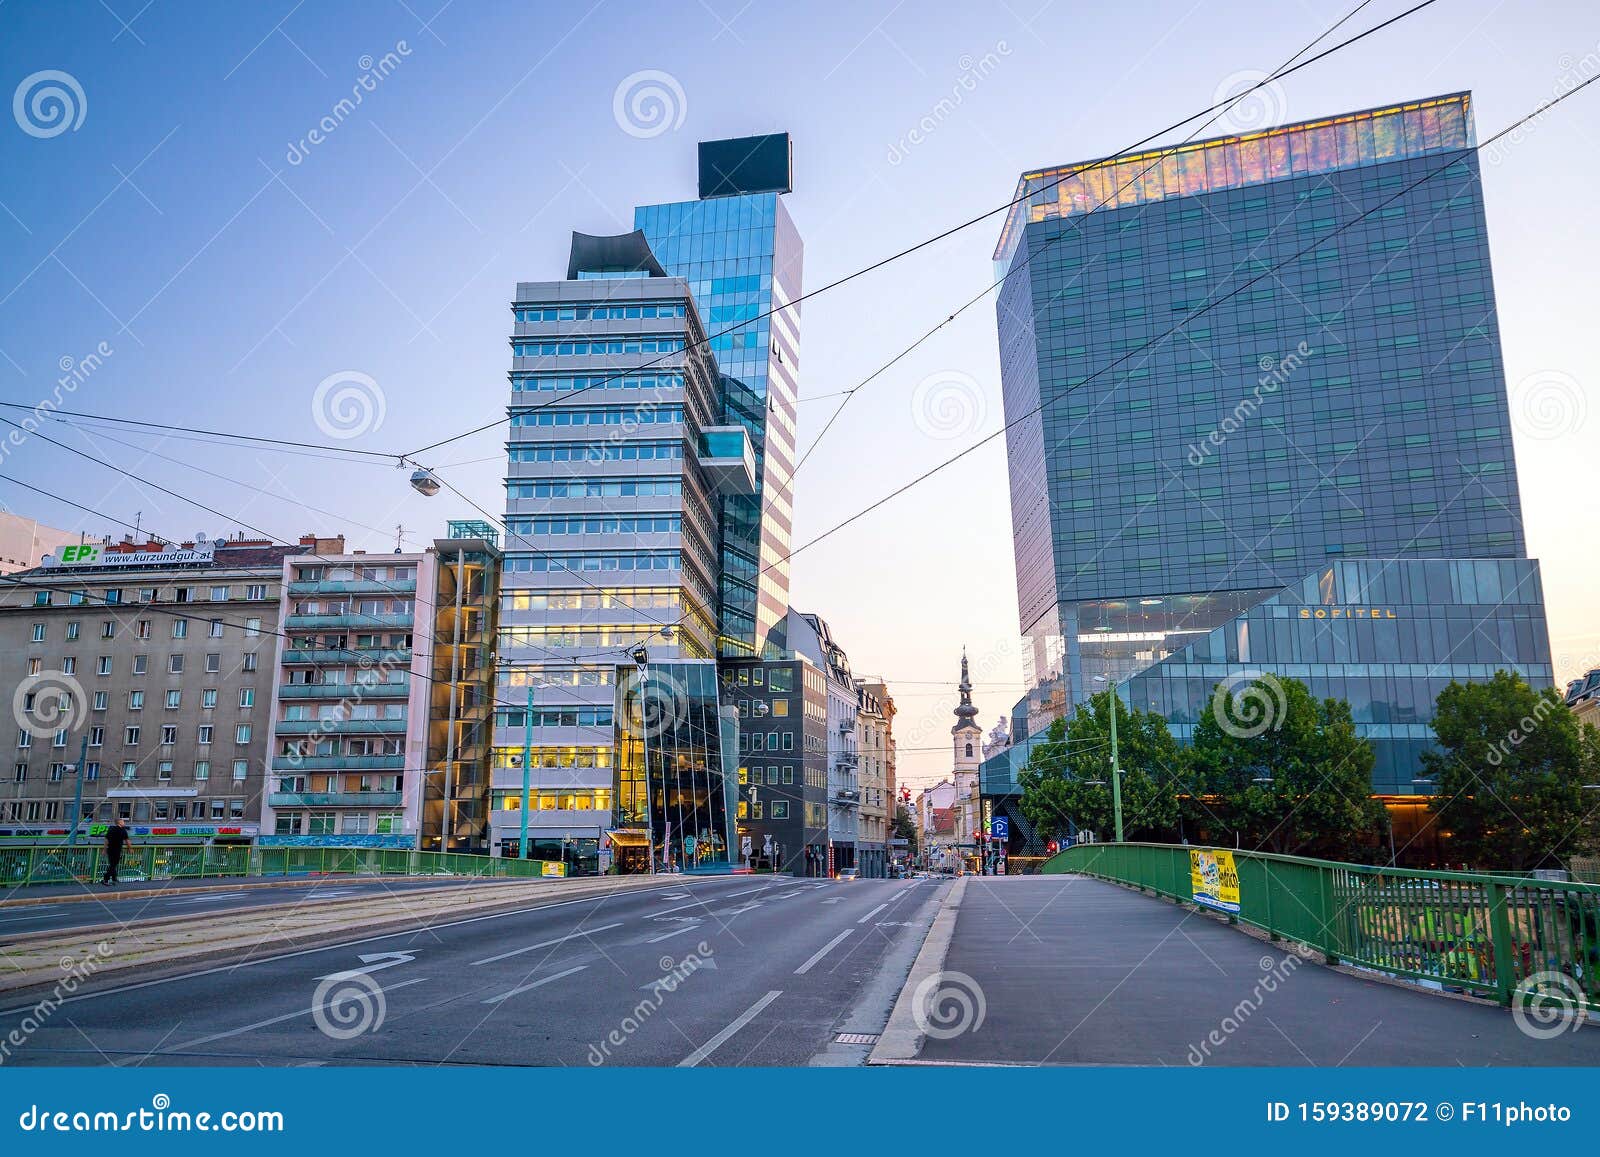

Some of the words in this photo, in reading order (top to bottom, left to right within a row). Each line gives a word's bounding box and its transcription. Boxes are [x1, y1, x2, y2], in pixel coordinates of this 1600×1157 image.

[62, 546, 98, 562] EP:
[1300, 609, 1396, 618] SOFITEL
[996, 823, 1004, 834] P
